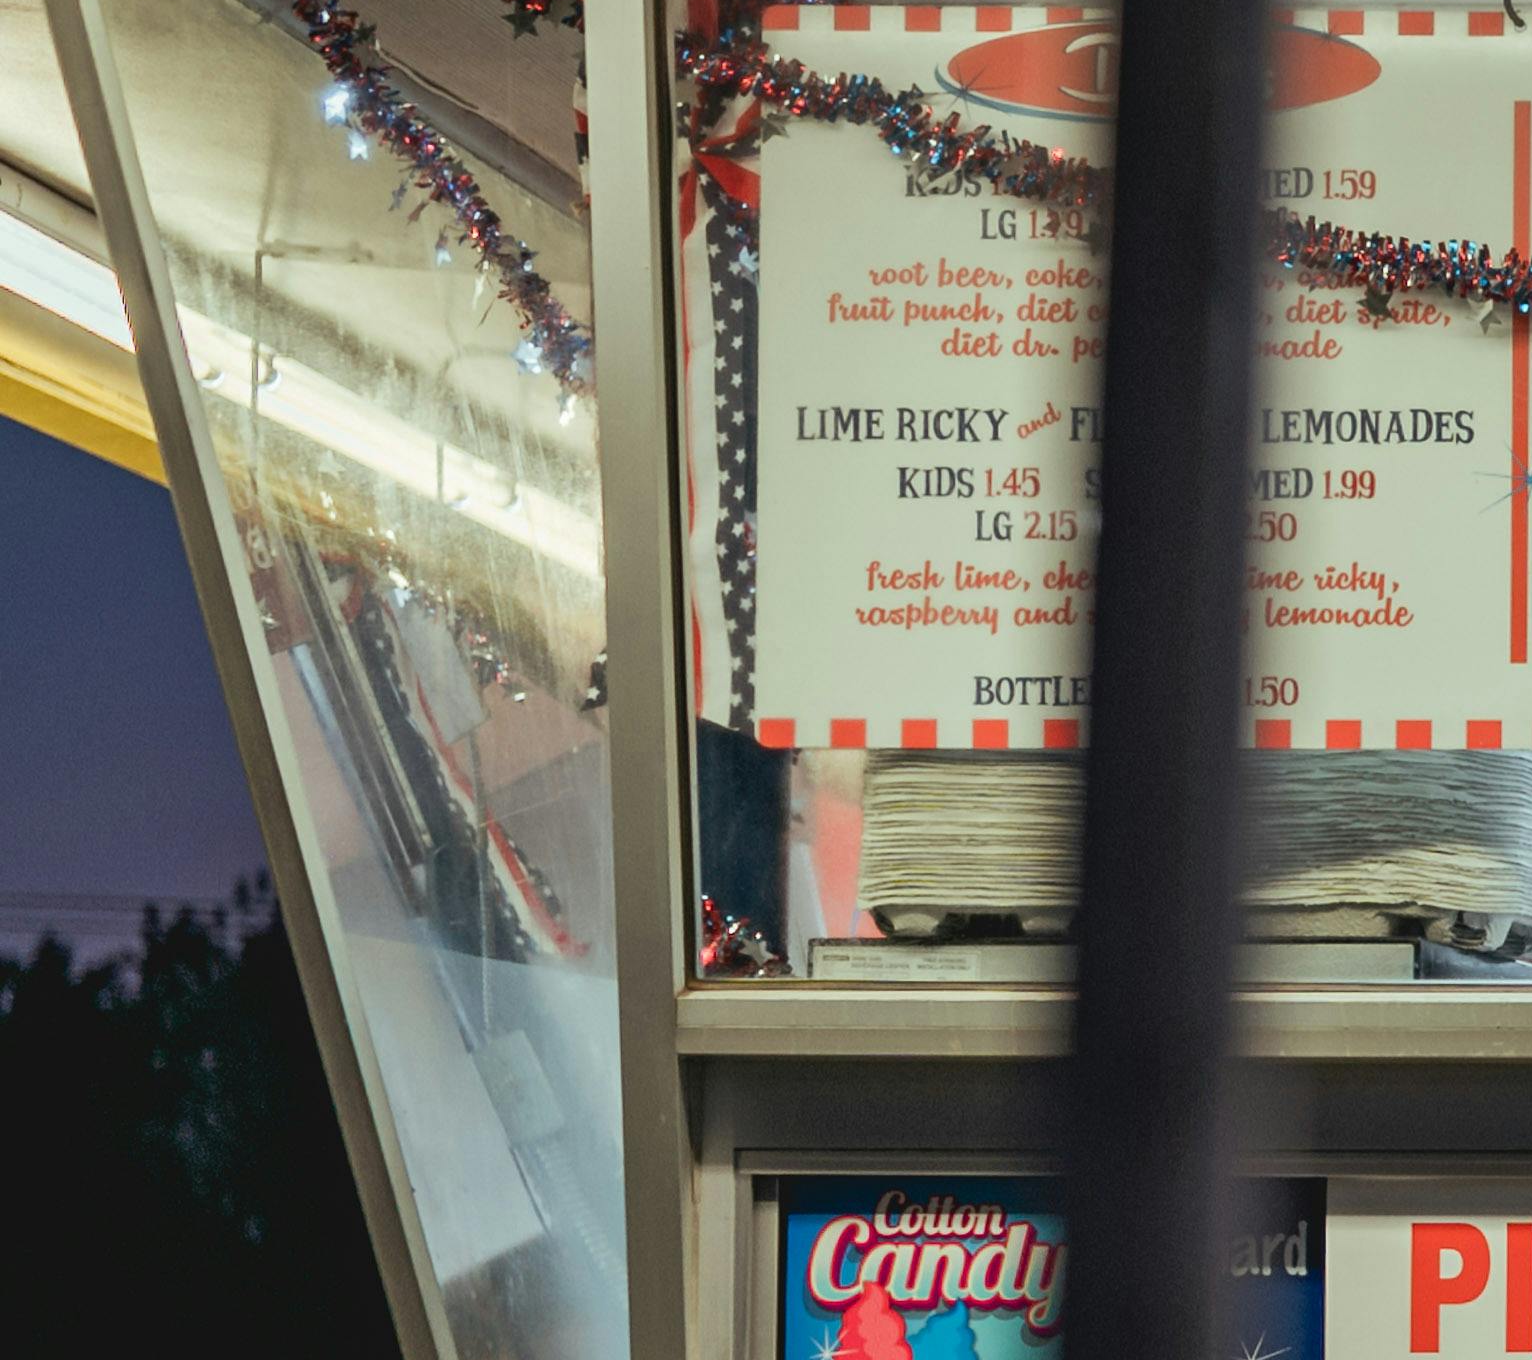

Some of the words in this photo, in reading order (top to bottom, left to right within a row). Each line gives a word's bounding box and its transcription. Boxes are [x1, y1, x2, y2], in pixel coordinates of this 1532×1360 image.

[796, 406, 885, 443] LIME
[896, 407, 1009, 443] RICKY
[1017, 402, 1063, 439] and
[1260, 406, 1475, 445] LEMONADES
[897, 466, 975, 499] KIDS
[985, 467, 1041, 498] 1.45
[1323, 470, 1376, 500] 1.99
[975, 510, 1013, 542] LG
[1025, 508, 1080, 544] 2.15
[855, 596, 999, 636] raspberry
[1014, 596, 1079, 629] and
[1264, 595, 1414, 629] lemonade
[873, 1188, 1007, 1238] Cotton
[806, 1214, 1068, 1336] Candy
